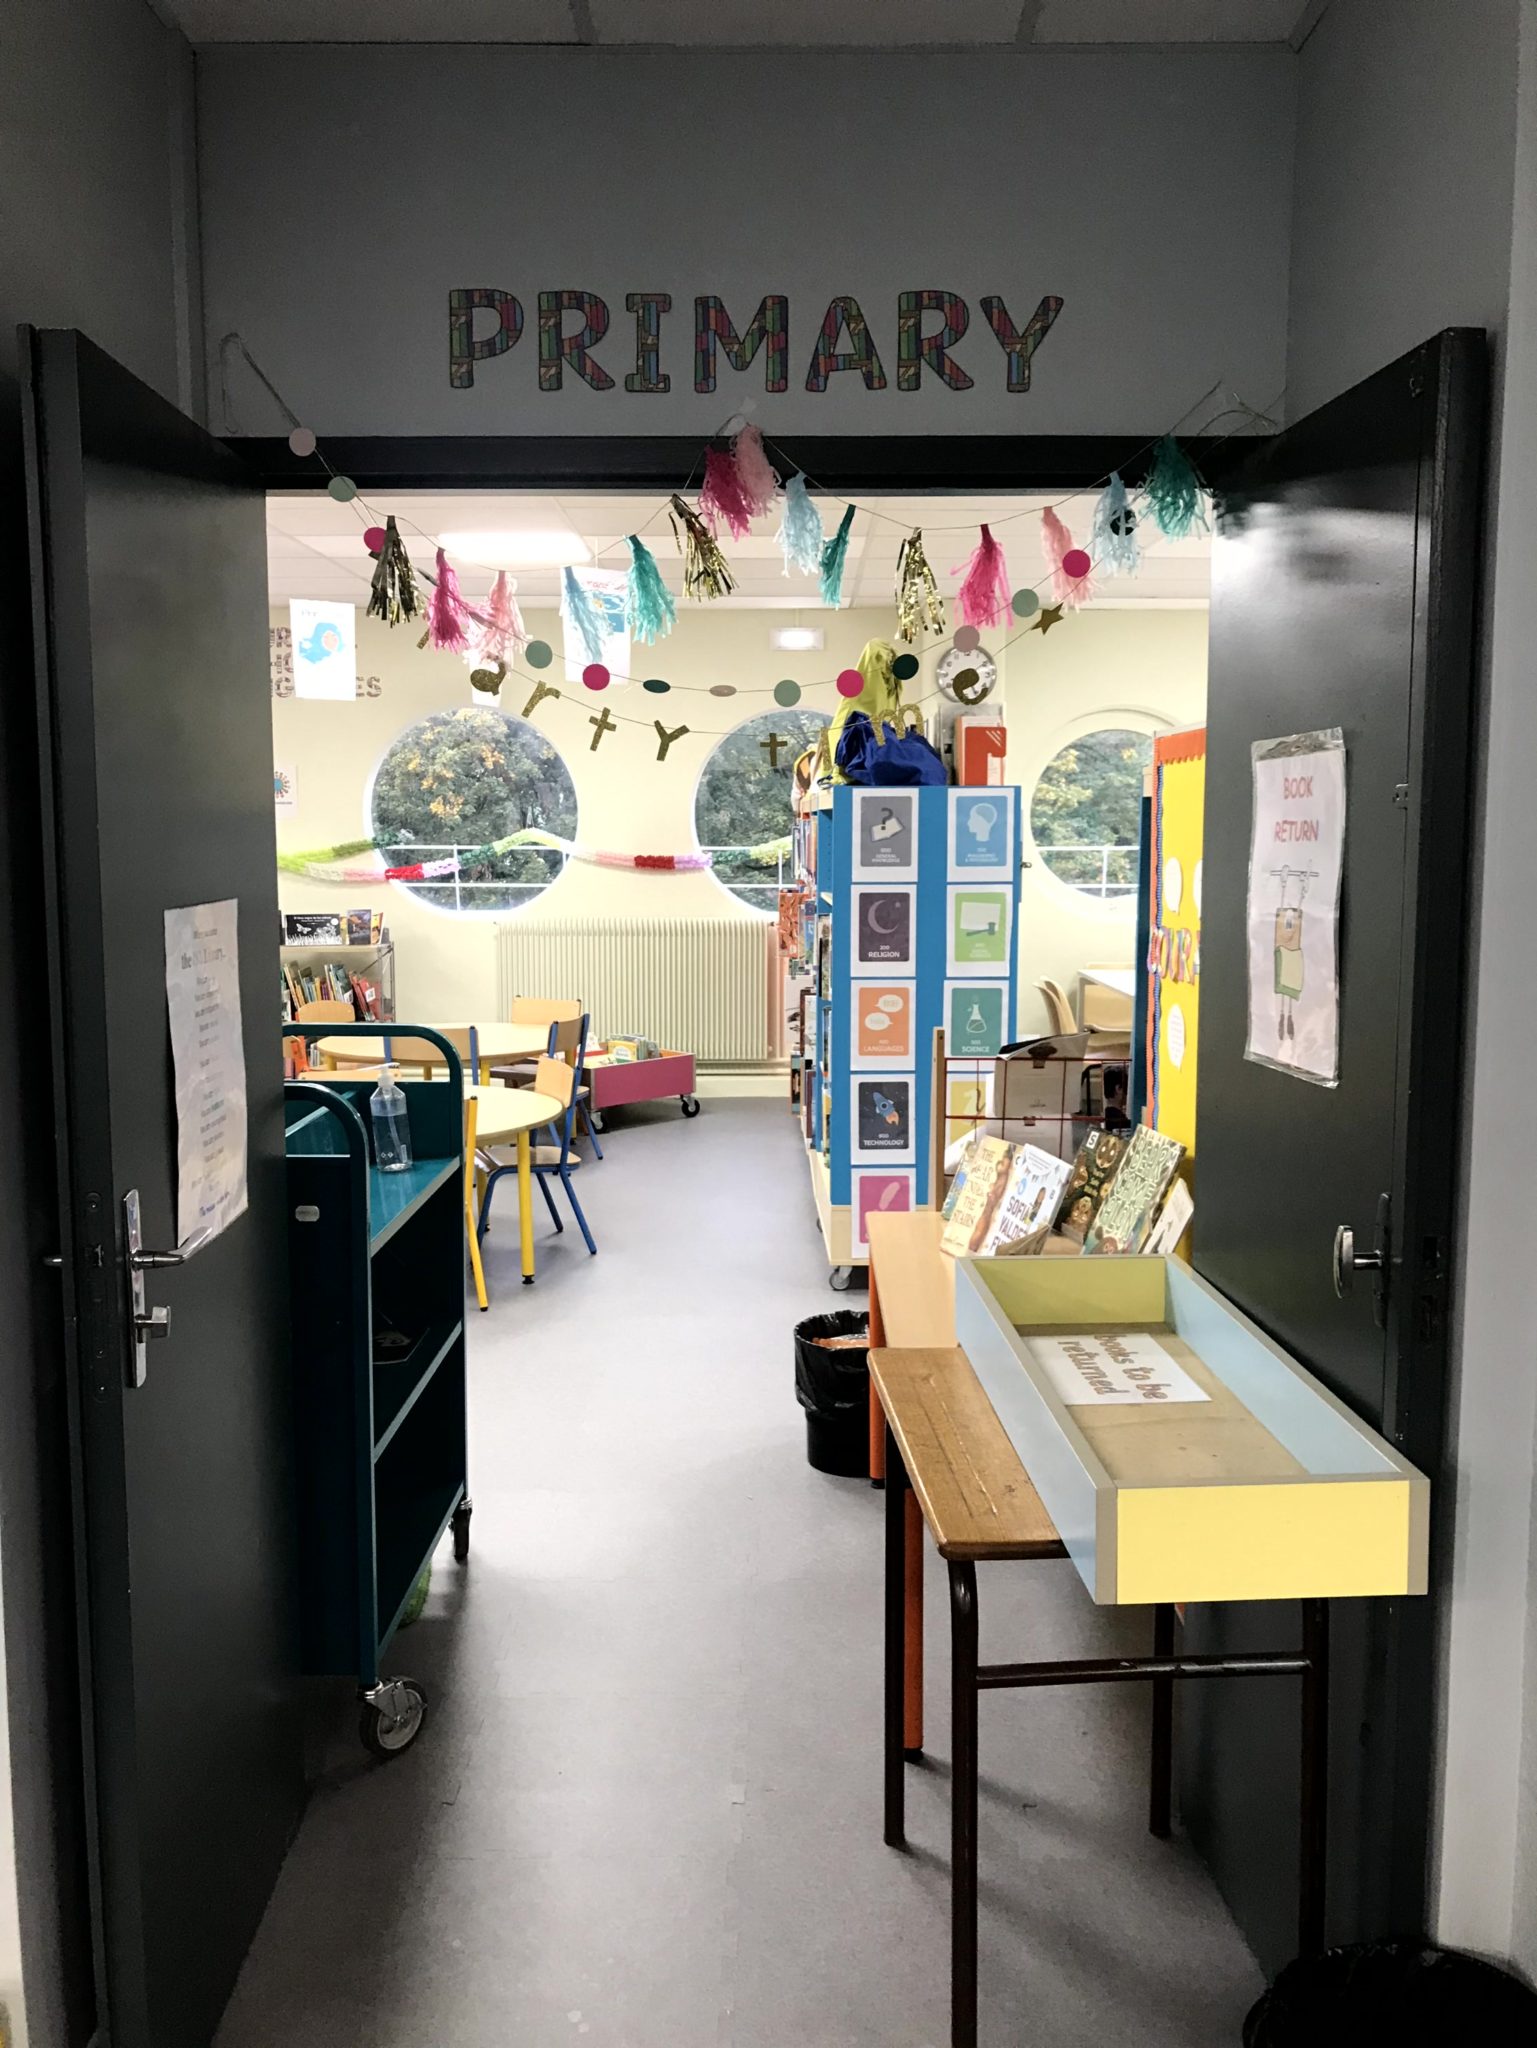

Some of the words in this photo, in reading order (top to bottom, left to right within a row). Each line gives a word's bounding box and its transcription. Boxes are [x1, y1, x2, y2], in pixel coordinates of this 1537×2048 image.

[449, 288, 1064, 393] PRIMARY
[1283, 775, 1315, 800] BOOK
[1273, 819, 1319, 844] RETURN
[1094, 1334, 1139, 1365] books
[1057, 1341, 1130, 1396] returned
[1122, 1366, 1156, 1381] to
[1136, 1383, 1172, 1400] be
